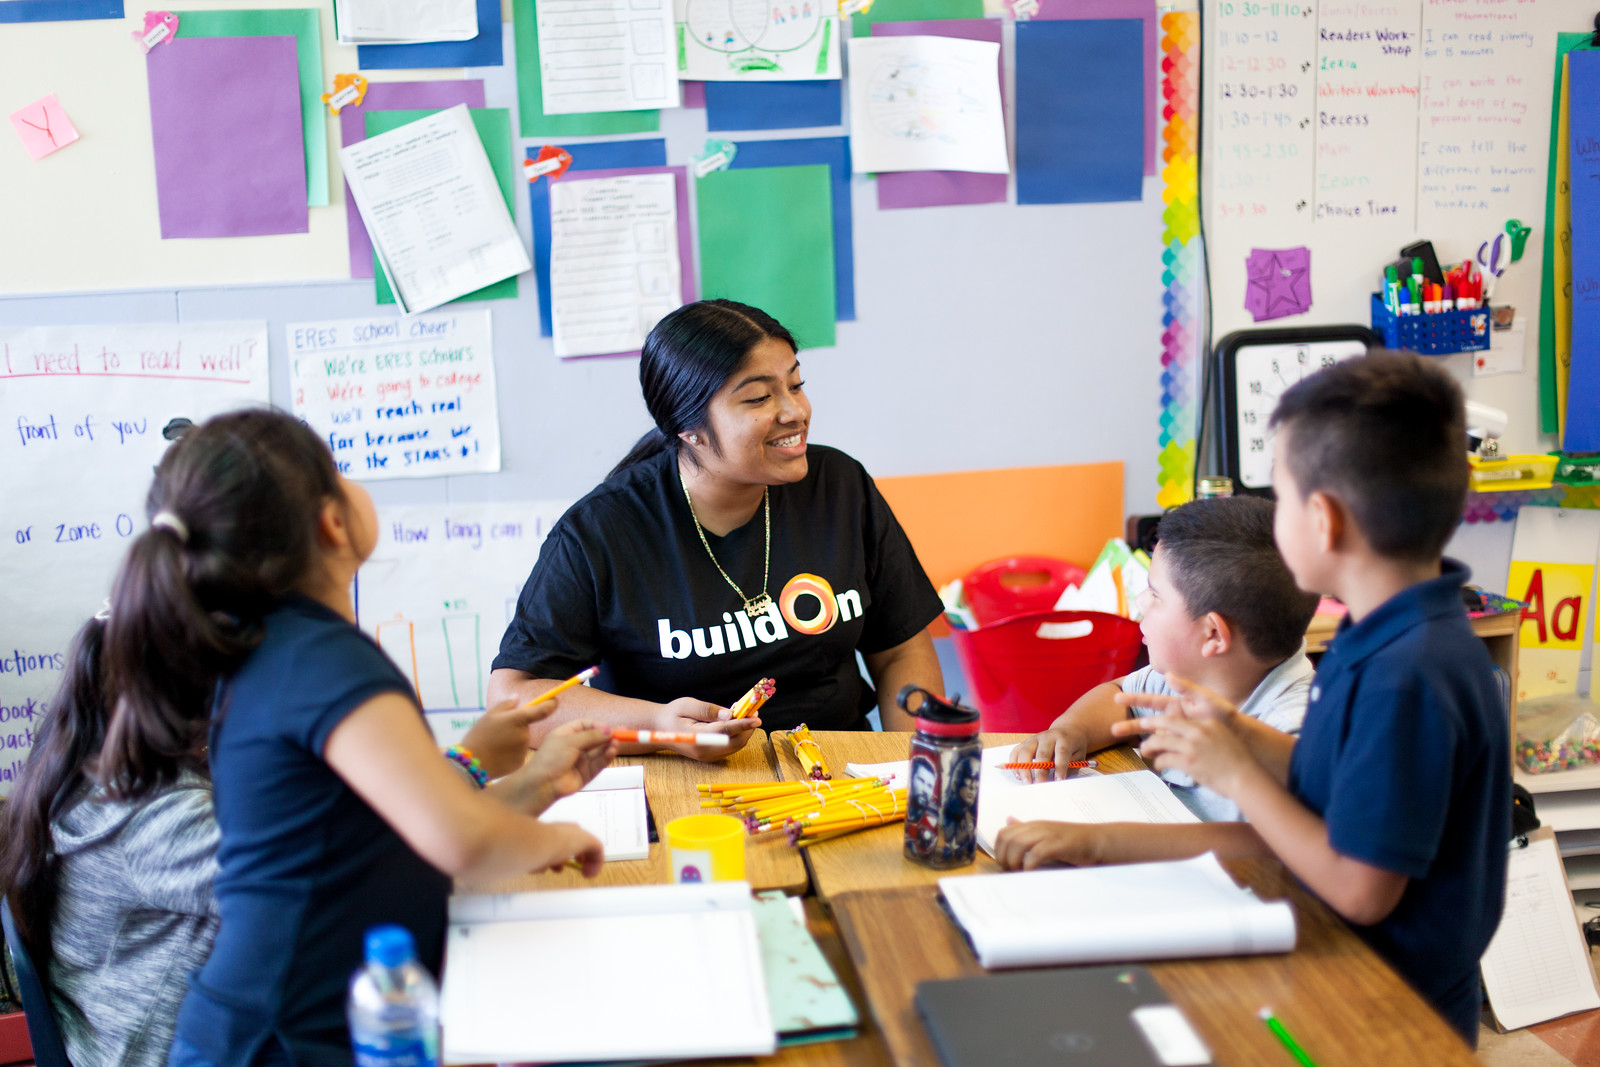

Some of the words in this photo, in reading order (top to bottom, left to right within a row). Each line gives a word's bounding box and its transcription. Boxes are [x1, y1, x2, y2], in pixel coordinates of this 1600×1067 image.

[1319, 27, 1371, 42] Readers
[1442, 33, 1459, 42] can
[1468, 31, 1492, 42] read
[1382, 44, 1412, 57] shop
[1319, 111, 1370, 130] Recess
[1316, 202, 1361, 219] Choice
[1367, 199, 1398, 216] Time
[294, 327, 338, 350] ERES
[34, 342, 81, 375] need
[96, 346, 121, 372] to
[141, 339, 182, 371] read
[199, 337, 258, 372] well?
[324, 354, 367, 377] We're
[376, 351, 412, 371] ERES
[327, 380, 364, 401] We're
[376, 378, 412, 401] going
[419, 373, 430, 387] to
[436, 371, 482, 393] college
[1249, 381, 1262, 394] 10
[376, 399, 423, 420] reach
[431, 395, 462, 414] real
[1244, 411, 1256, 424] 15
[17, 413, 58, 447] front
[74, 413, 100, 442] of
[111, 416, 148, 445] you
[329, 431, 354, 452] far
[365, 428, 430, 447] because
[451, 424, 472, 439] we
[1251, 438, 1264, 451] 20
[366, 451, 389, 470] the
[403, 447, 451, 467] STARS
[15, 525, 34, 545] or
[392, 522, 429, 543] How
[444, 517, 482, 550] long
[491, 523, 523, 540] can
[657, 572, 864, 660] buildOn
[1519, 568, 1582, 644] Aa
